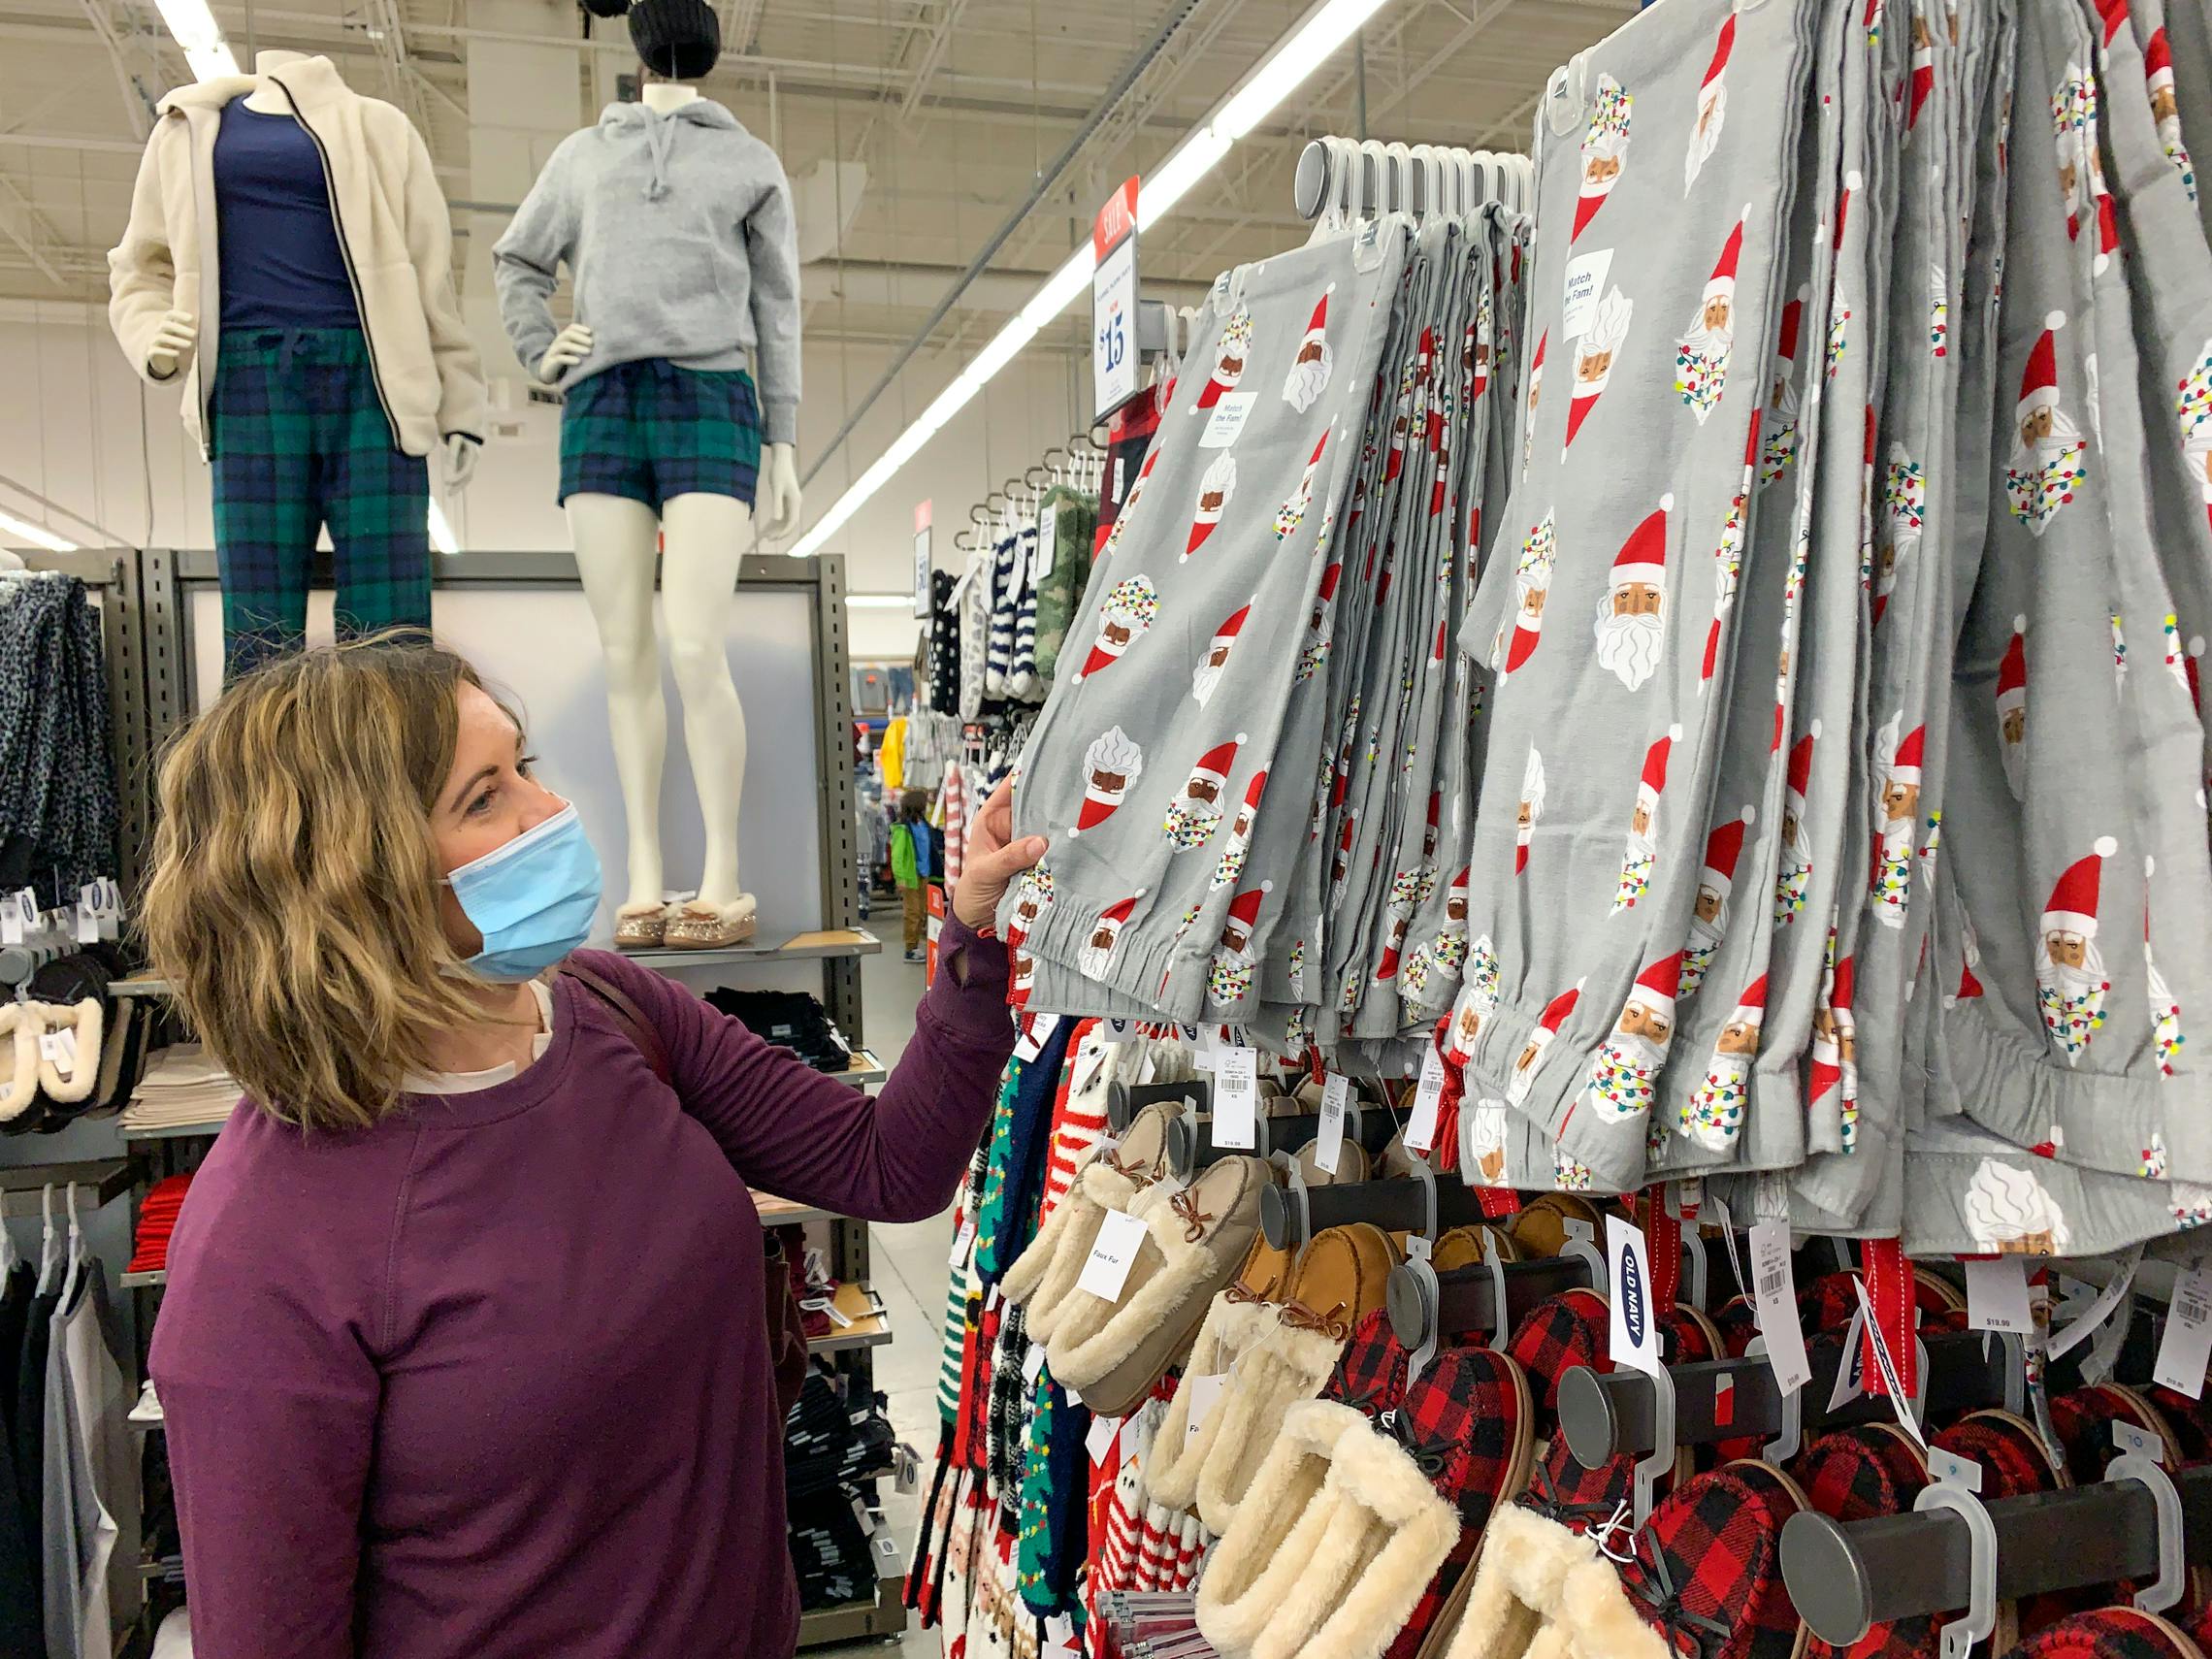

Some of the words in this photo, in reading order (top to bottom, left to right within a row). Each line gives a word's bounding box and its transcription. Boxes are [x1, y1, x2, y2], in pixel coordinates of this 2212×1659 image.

[1102, 201, 1122, 244] SALE
[1568, 272, 1591, 289] Match
[1572, 285, 1594, 302] Fam!
[1099, 310, 1123, 374] $15
[1224, 404, 1242, 412] Match
[1225, 413, 1242, 422] Fam!
[1093, 1250, 1107, 1260] Faux
[1108, 1255, 1119, 1265] Fur
[1625, 1255, 1636, 1288] OLD
[1628, 1289, 1641, 1337] NAVY
[1949, 1464, 1957, 1476] 9
